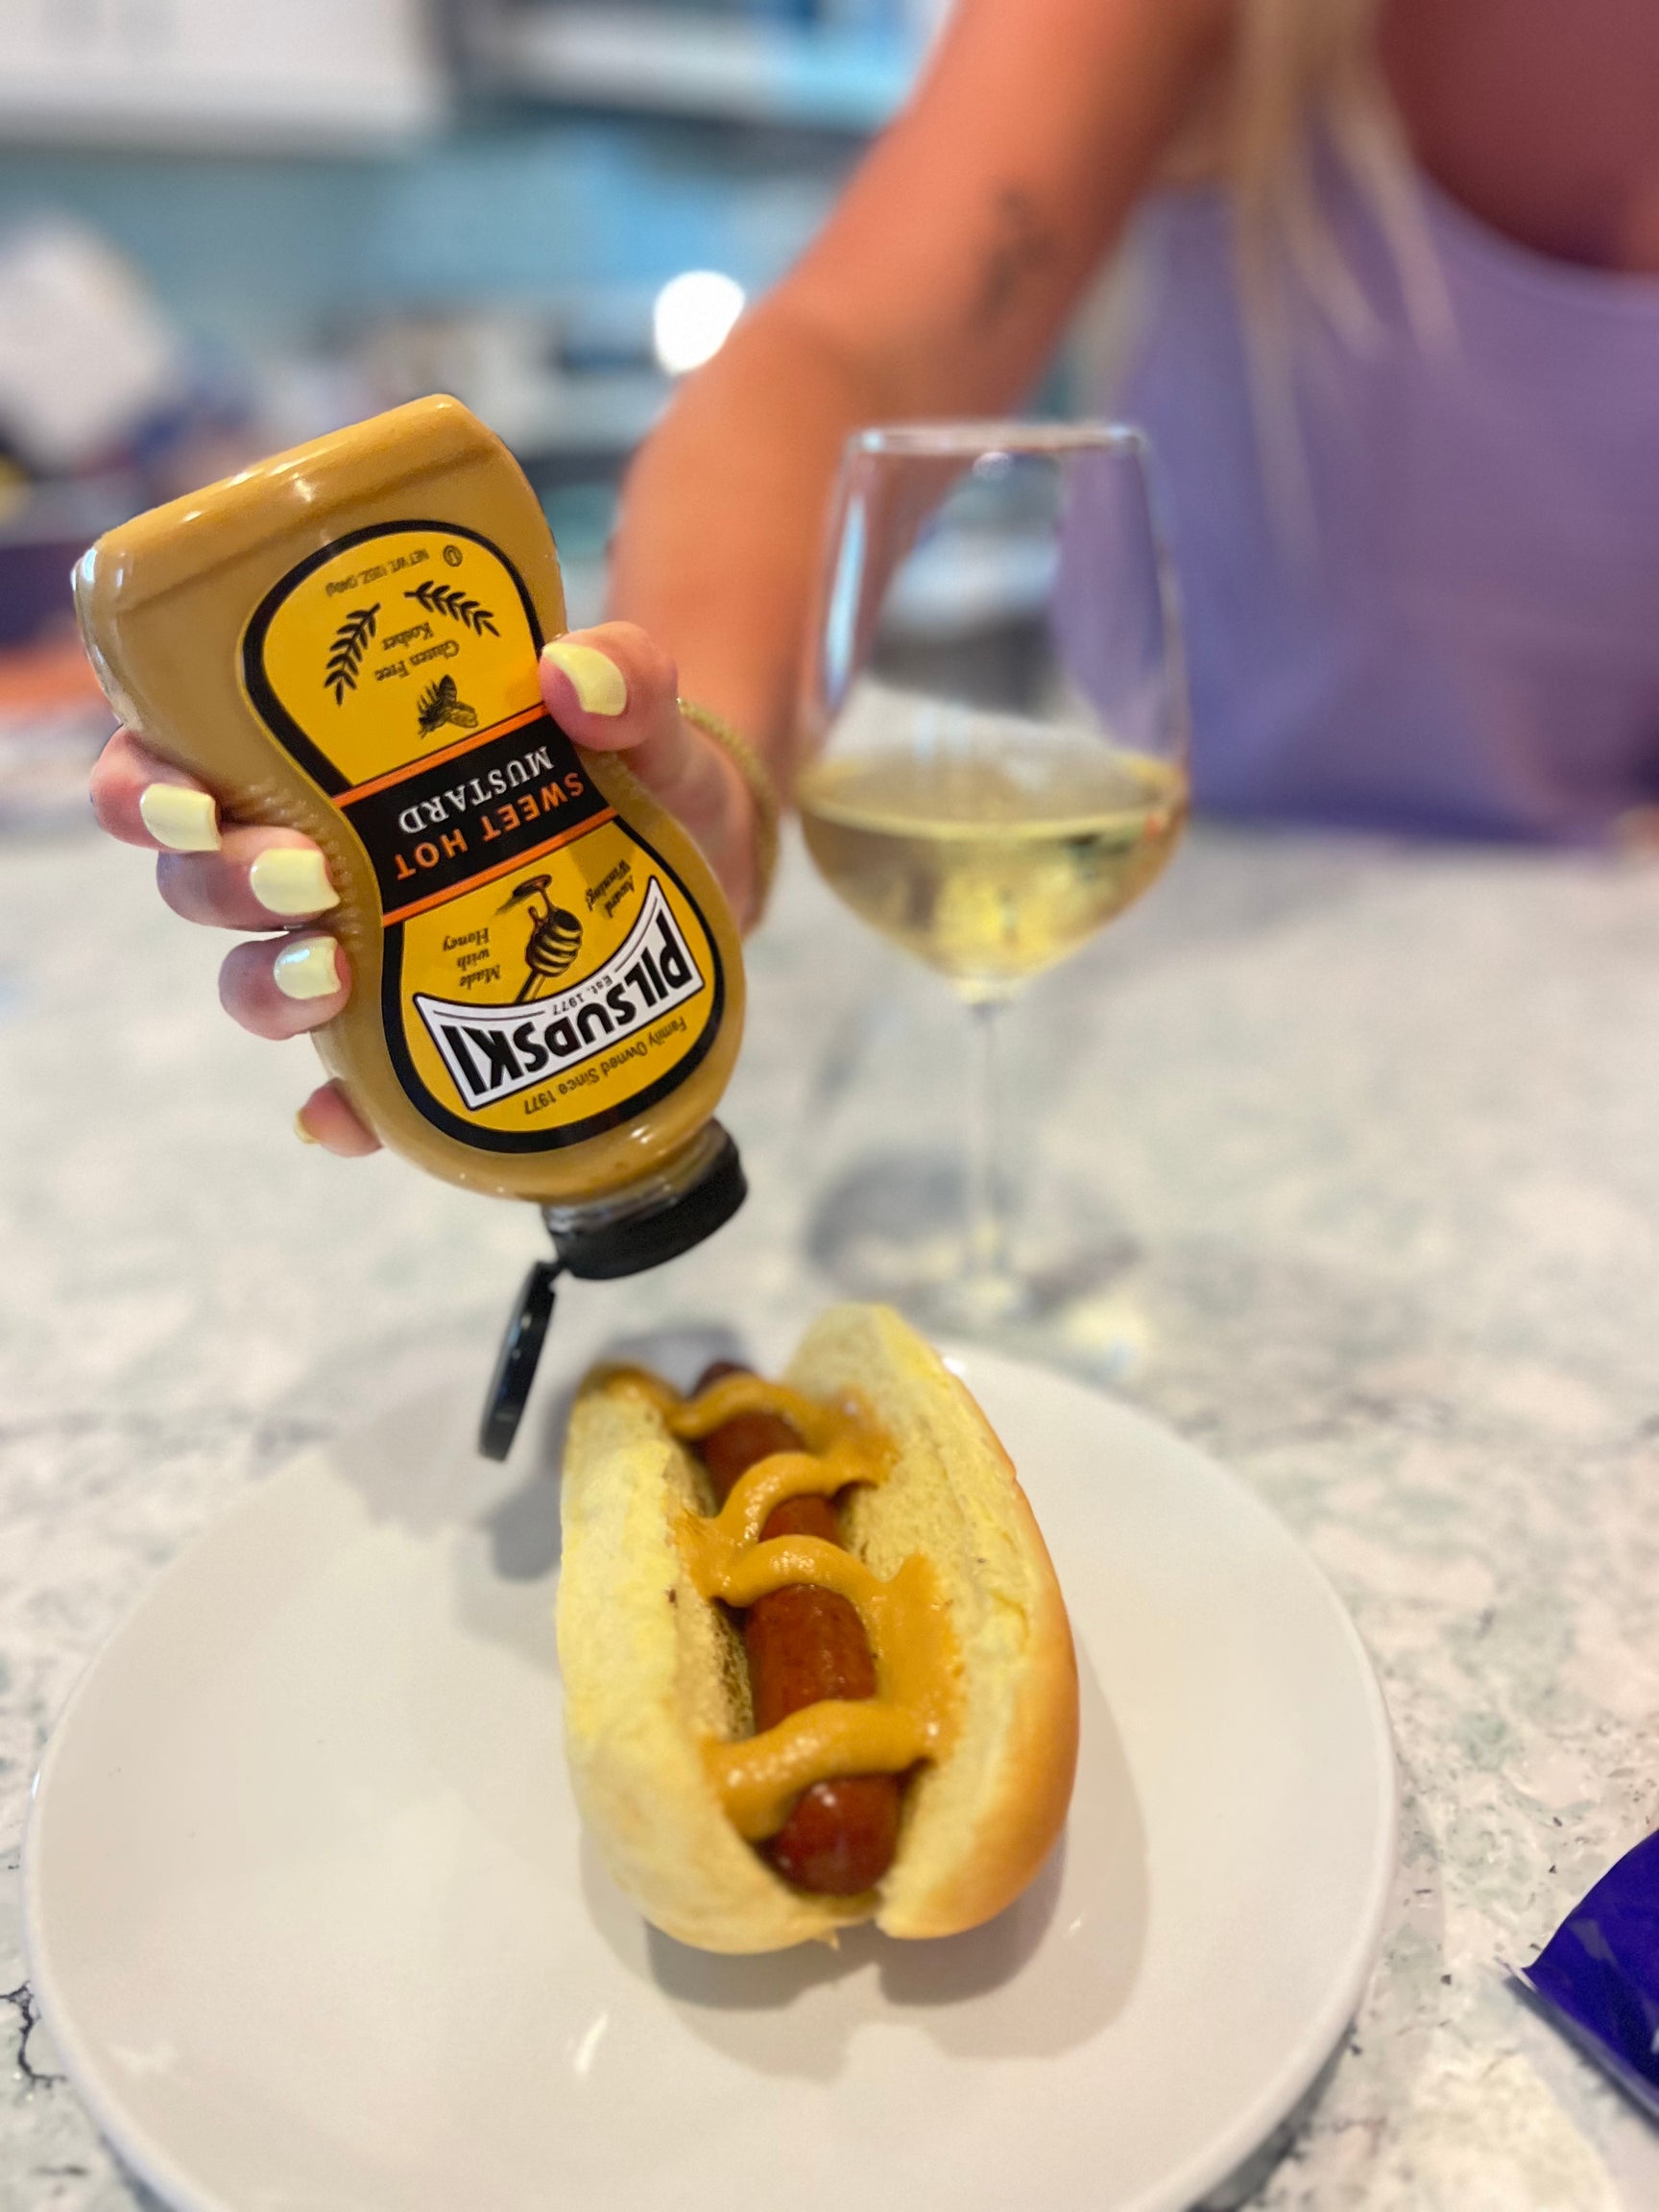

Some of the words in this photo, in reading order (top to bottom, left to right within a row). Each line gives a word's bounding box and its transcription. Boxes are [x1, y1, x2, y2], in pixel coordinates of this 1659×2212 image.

[408, 549, 430, 565] NET
[382, 621, 434, 651] Kosher
[409, 639, 460, 666] Gluten
[374, 660, 410, 682] Free
[398, 745, 555, 834] MUSTARD
[481, 772, 585, 842] SWEET
[394, 828, 469, 881] HOT
[585, 858, 632, 912] Winning!
[605, 875, 635, 919] Award
[443, 927, 490, 951] Honey
[457, 949, 491, 972] with
[458, 964, 501, 991] Made
[587, 974, 613, 996] Est.
[440, 908, 693, 1096] PILSUDSKI
[552, 993, 585, 1017] 1977
[648, 1016, 687, 1047] Family
[600, 1040, 648, 1076] Owned
[558, 1067, 600, 1095] Since
[524, 1089, 558, 1116] 1977
